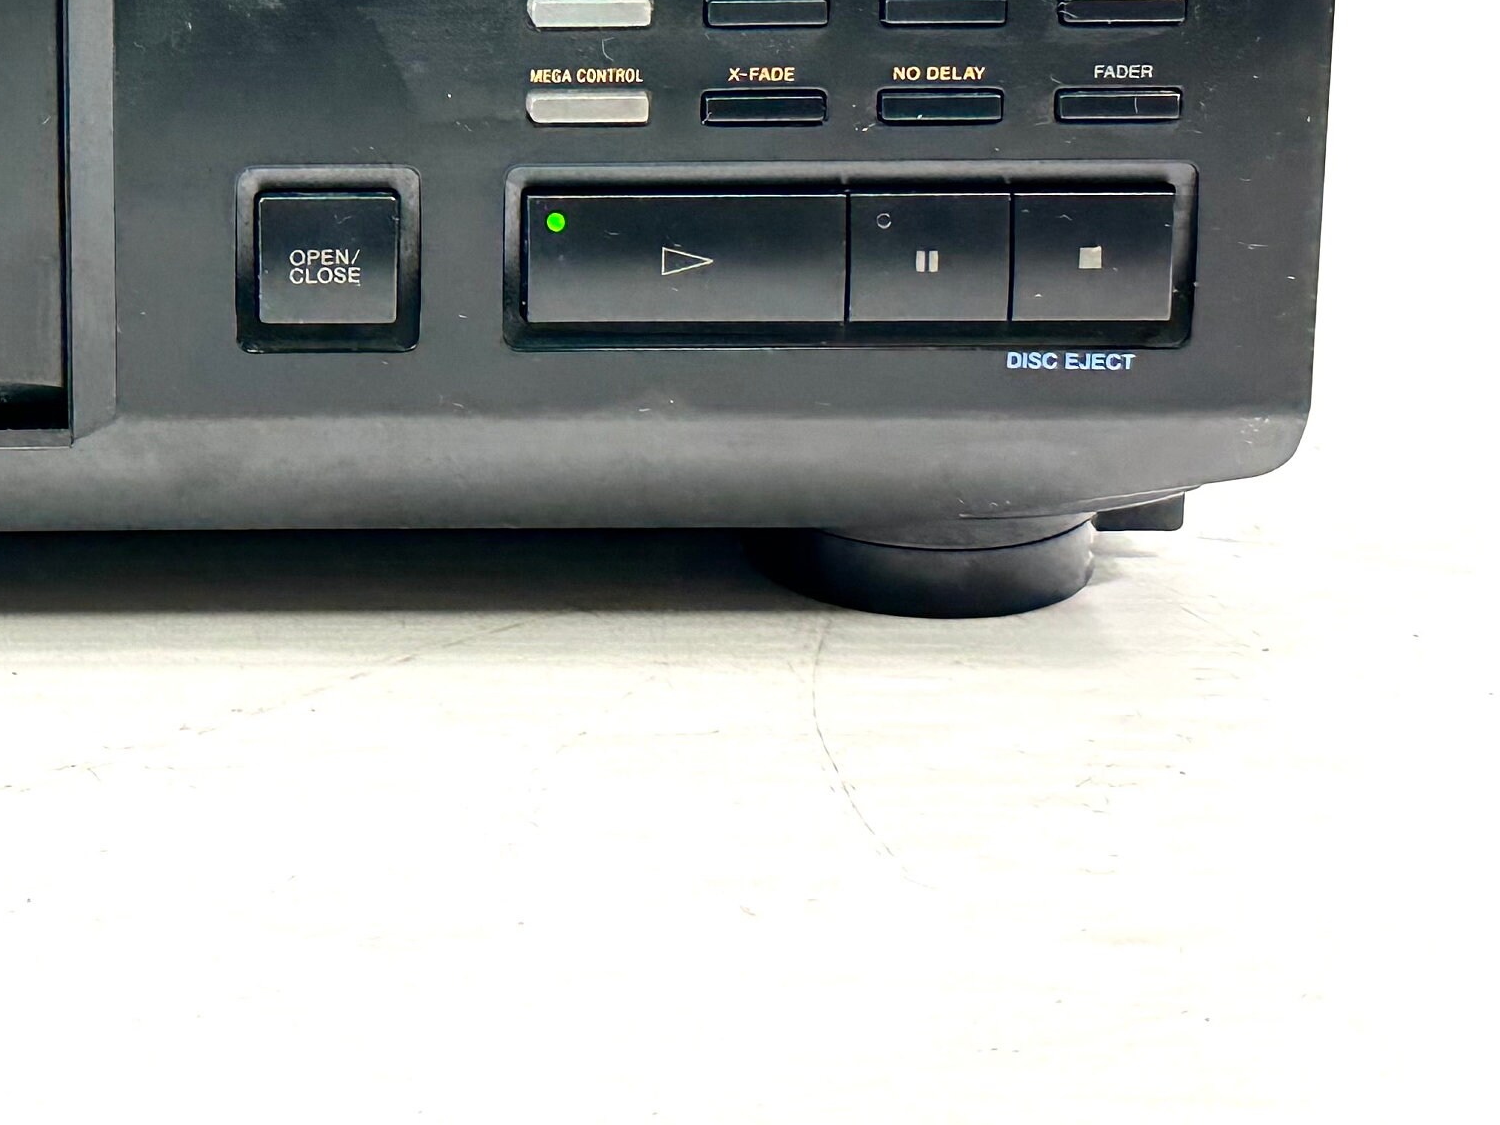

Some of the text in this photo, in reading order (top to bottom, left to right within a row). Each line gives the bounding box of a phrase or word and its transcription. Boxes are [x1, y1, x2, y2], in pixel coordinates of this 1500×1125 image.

[530, 68, 644, 83] MEGA CONTROL
[727, 67, 796, 82] X-FADE
[892, 66, 986, 81] NO DELAY
[1093, 65, 1154, 79] FADER
[289, 249, 361, 266] OPEN/
[289, 267, 361, 284] CLOSE
[1006, 351, 1137, 371] DISC EJECT
